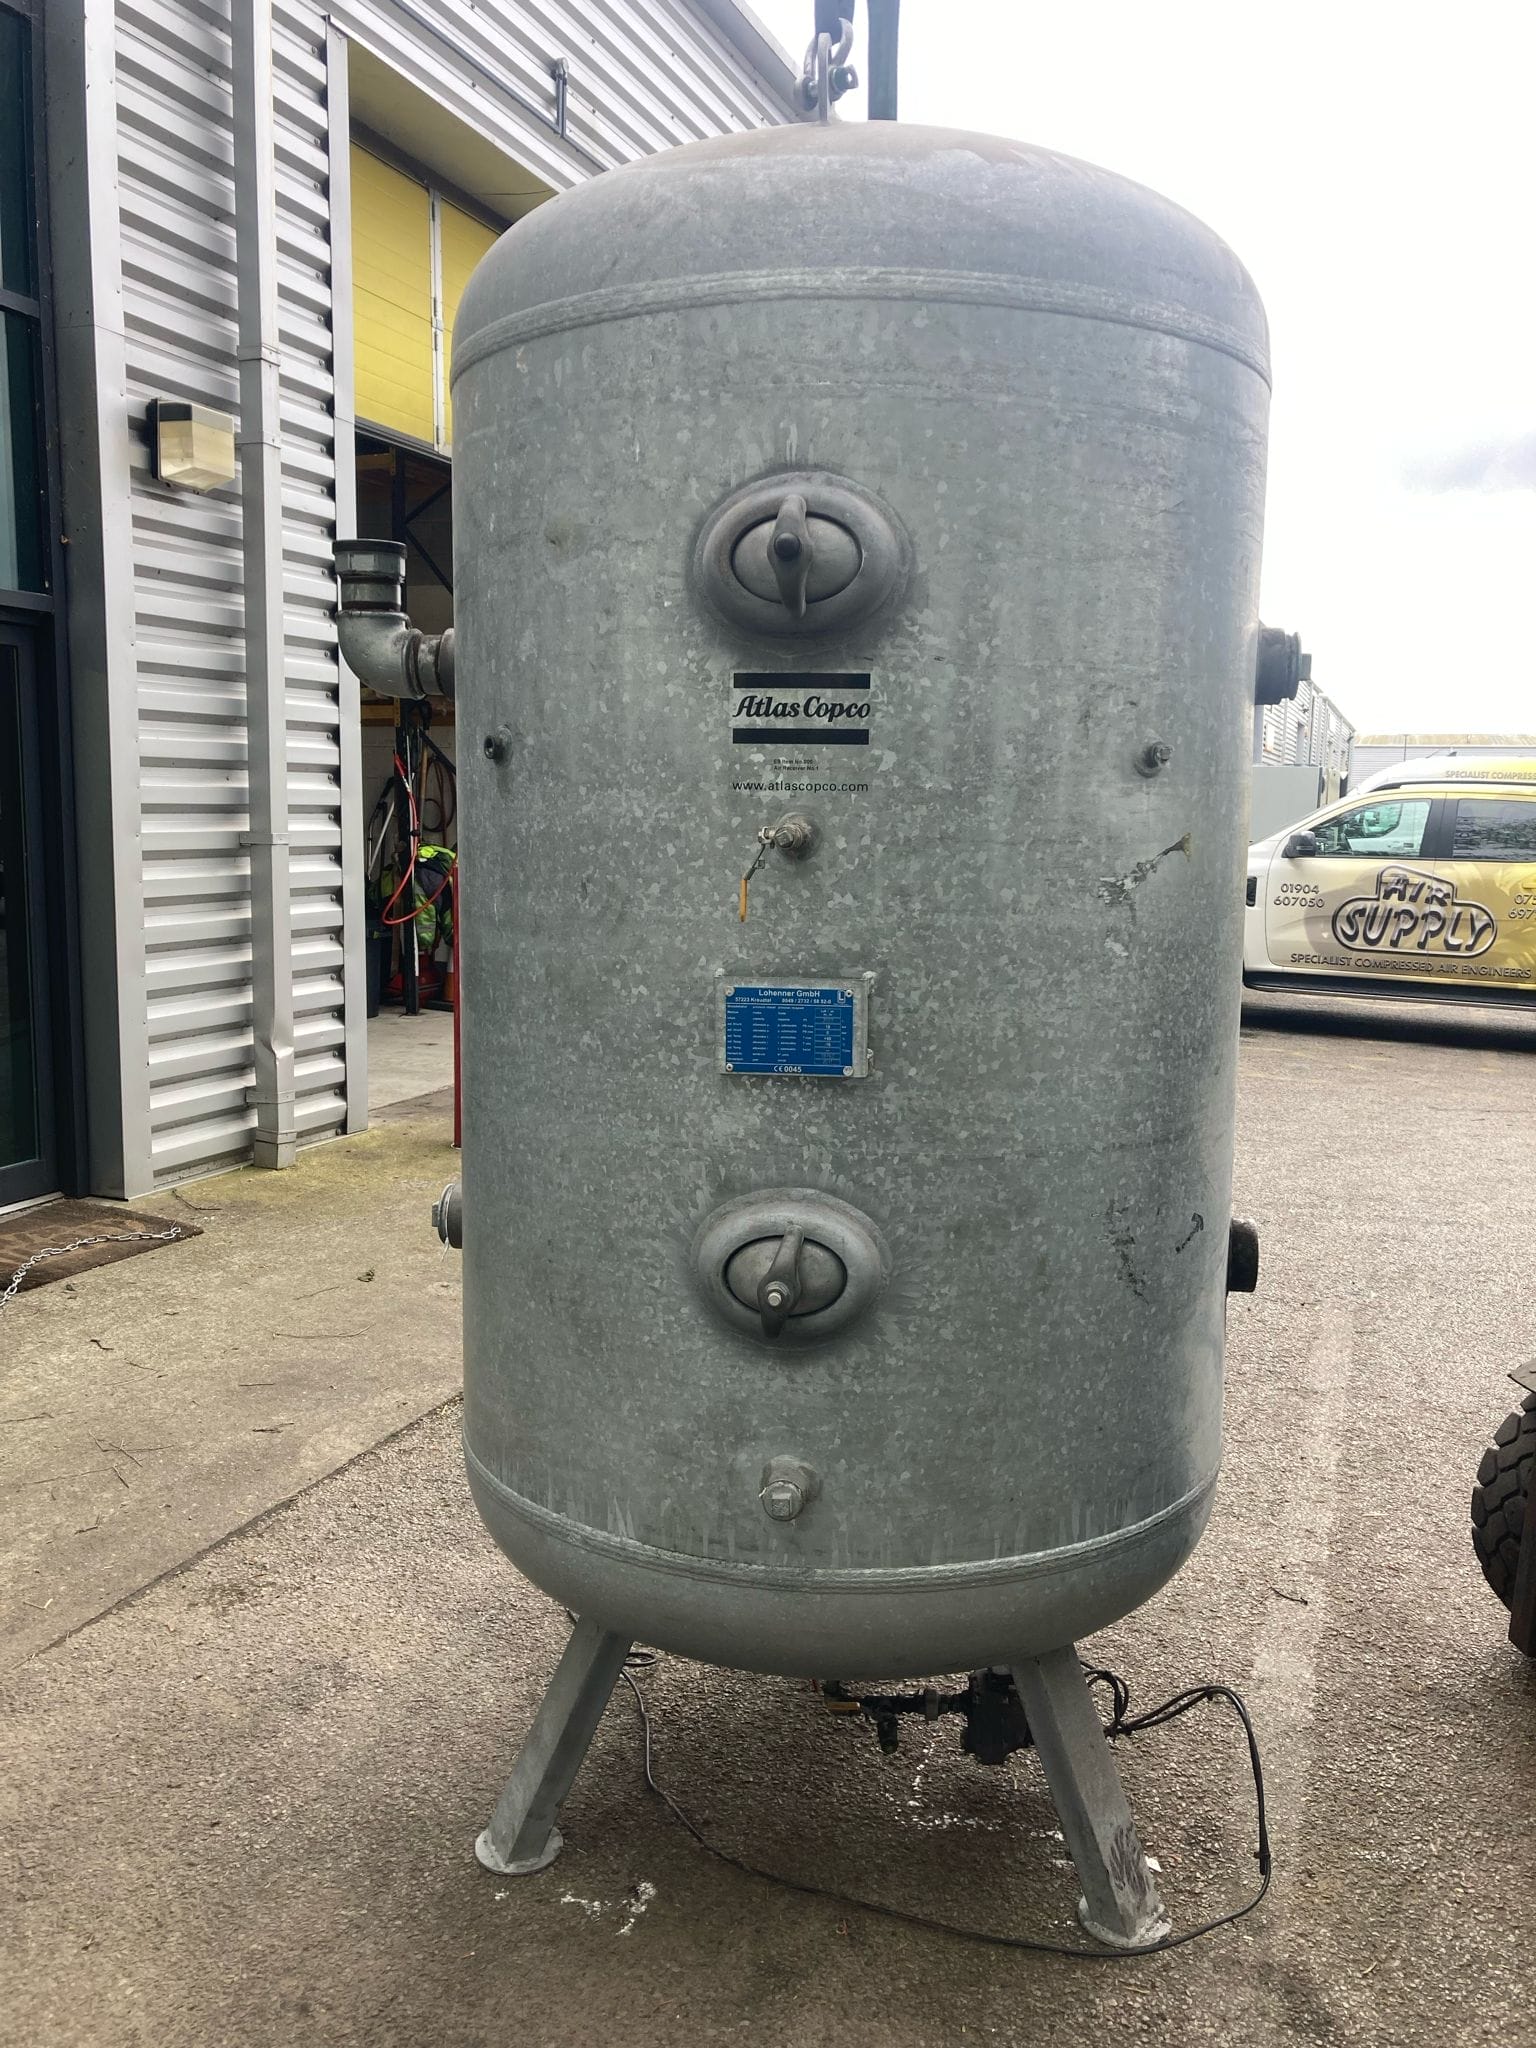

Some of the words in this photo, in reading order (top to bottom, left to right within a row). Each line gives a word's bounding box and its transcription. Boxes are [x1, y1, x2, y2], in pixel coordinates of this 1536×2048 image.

[732, 695, 800, 718] Atlas
[803, 696, 871, 722] Copco
[1446, 770, 1490, 779] SPECIALIST
[732, 780, 869, 793] www.atlascopco.com
[1280, 883, 1320, 895] 01904
[1381, 872, 1451, 907] AIR
[1273, 895, 1325, 909] 607050
[1339, 904, 1493, 952] SUPPLY
[1290, 952, 1353, 967] SPECIALIST
[1354, 958, 1434, 972] COMPRESSED
[1437, 962, 1459, 974] AIR
[1461, 964, 1532, 979] ENGINEERS
[796, 989, 821, 998] GmbH
[783, 1065, 802, 1073] 0045
